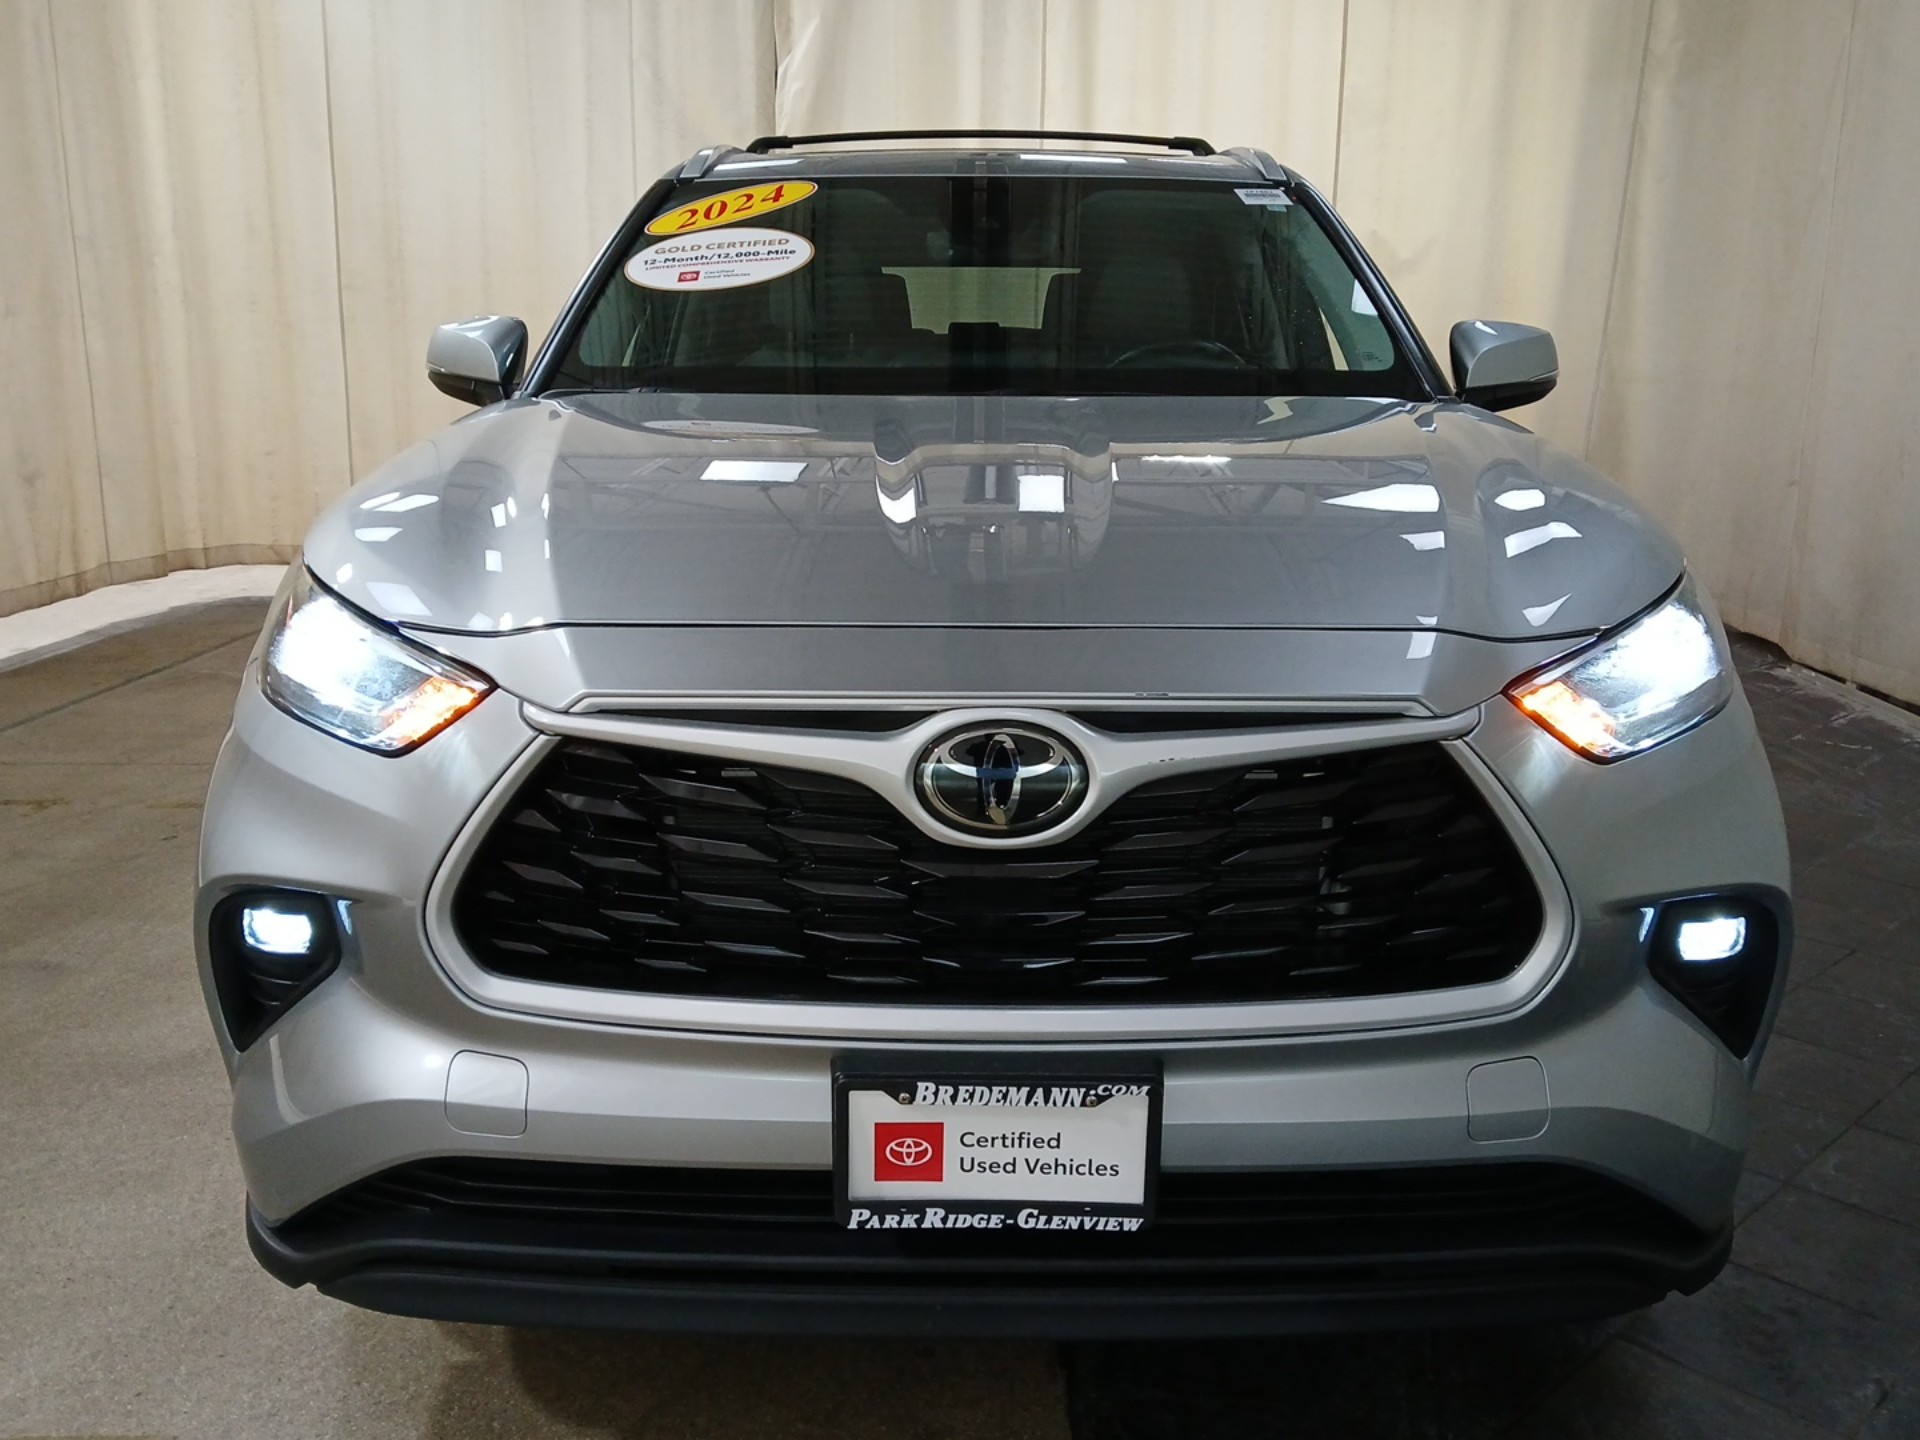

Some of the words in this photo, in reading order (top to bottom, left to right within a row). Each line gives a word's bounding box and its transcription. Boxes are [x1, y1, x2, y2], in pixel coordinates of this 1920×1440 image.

[676, 184, 785, 230] 2024
[655, 244, 702, 255] GOLD
[705, 238, 790, 250] CERTIFIED
[644, 249, 796, 265] 12-Month/12,000-Mile
[959, 1131, 1062, 1150] Certified
[959, 1157, 1017, 1175] Used
[1024, 1158, 1120, 1177] Vehicles
